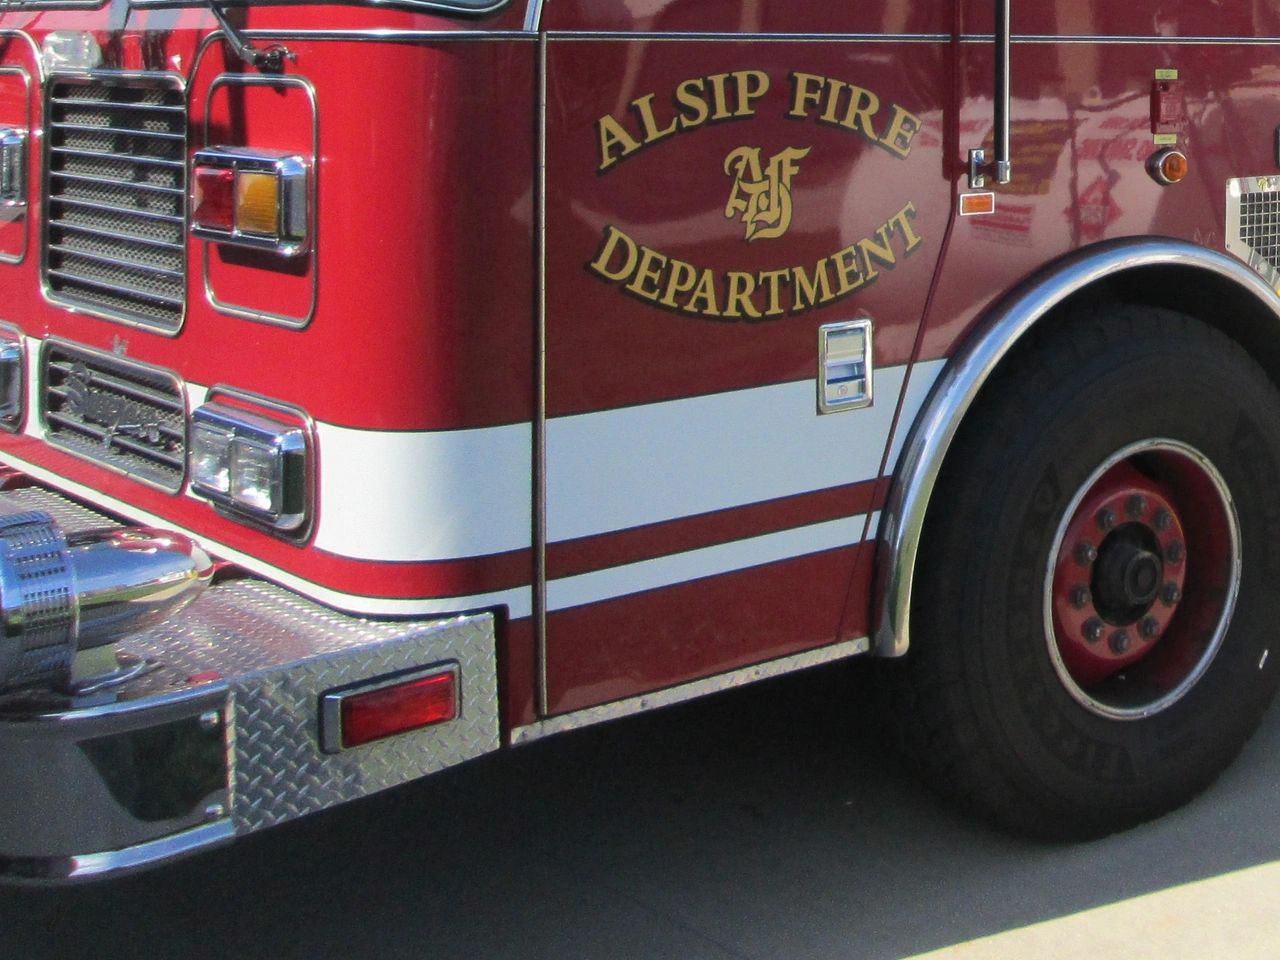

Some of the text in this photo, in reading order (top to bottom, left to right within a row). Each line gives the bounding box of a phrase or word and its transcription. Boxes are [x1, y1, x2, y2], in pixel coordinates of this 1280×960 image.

[597, 70, 922, 171] ALSIP FIRE
[588, 201, 922, 319] DEPARTMENT
